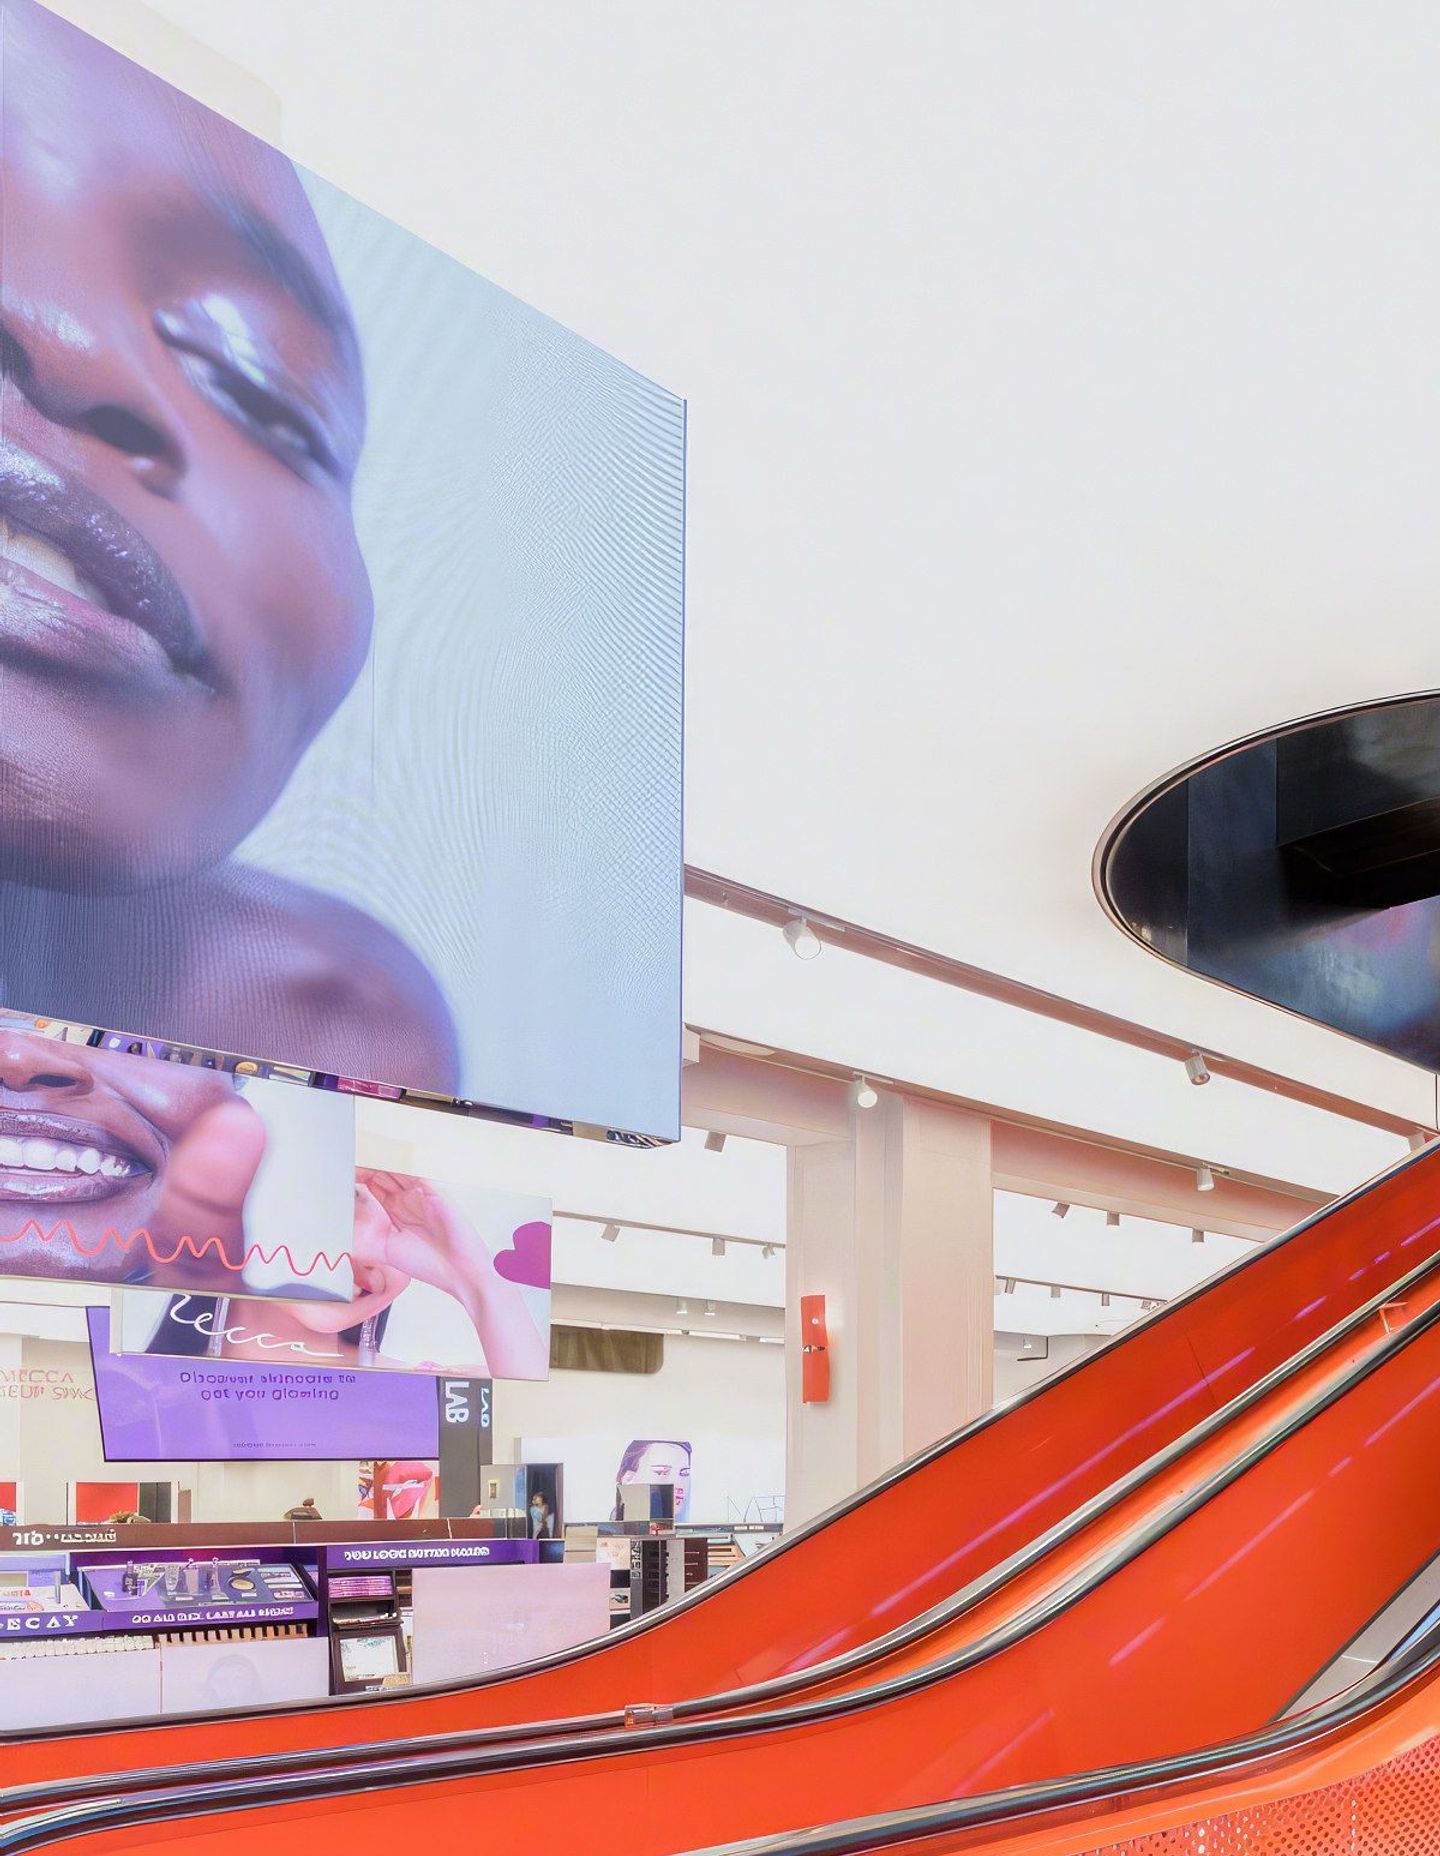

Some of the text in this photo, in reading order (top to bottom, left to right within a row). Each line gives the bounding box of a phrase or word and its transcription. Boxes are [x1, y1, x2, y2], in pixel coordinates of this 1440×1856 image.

[170, 1293, 344, 1357] ecca
[445, 1381, 470, 1423] LAB
[0, 1615, 79, 1631] ECAY
